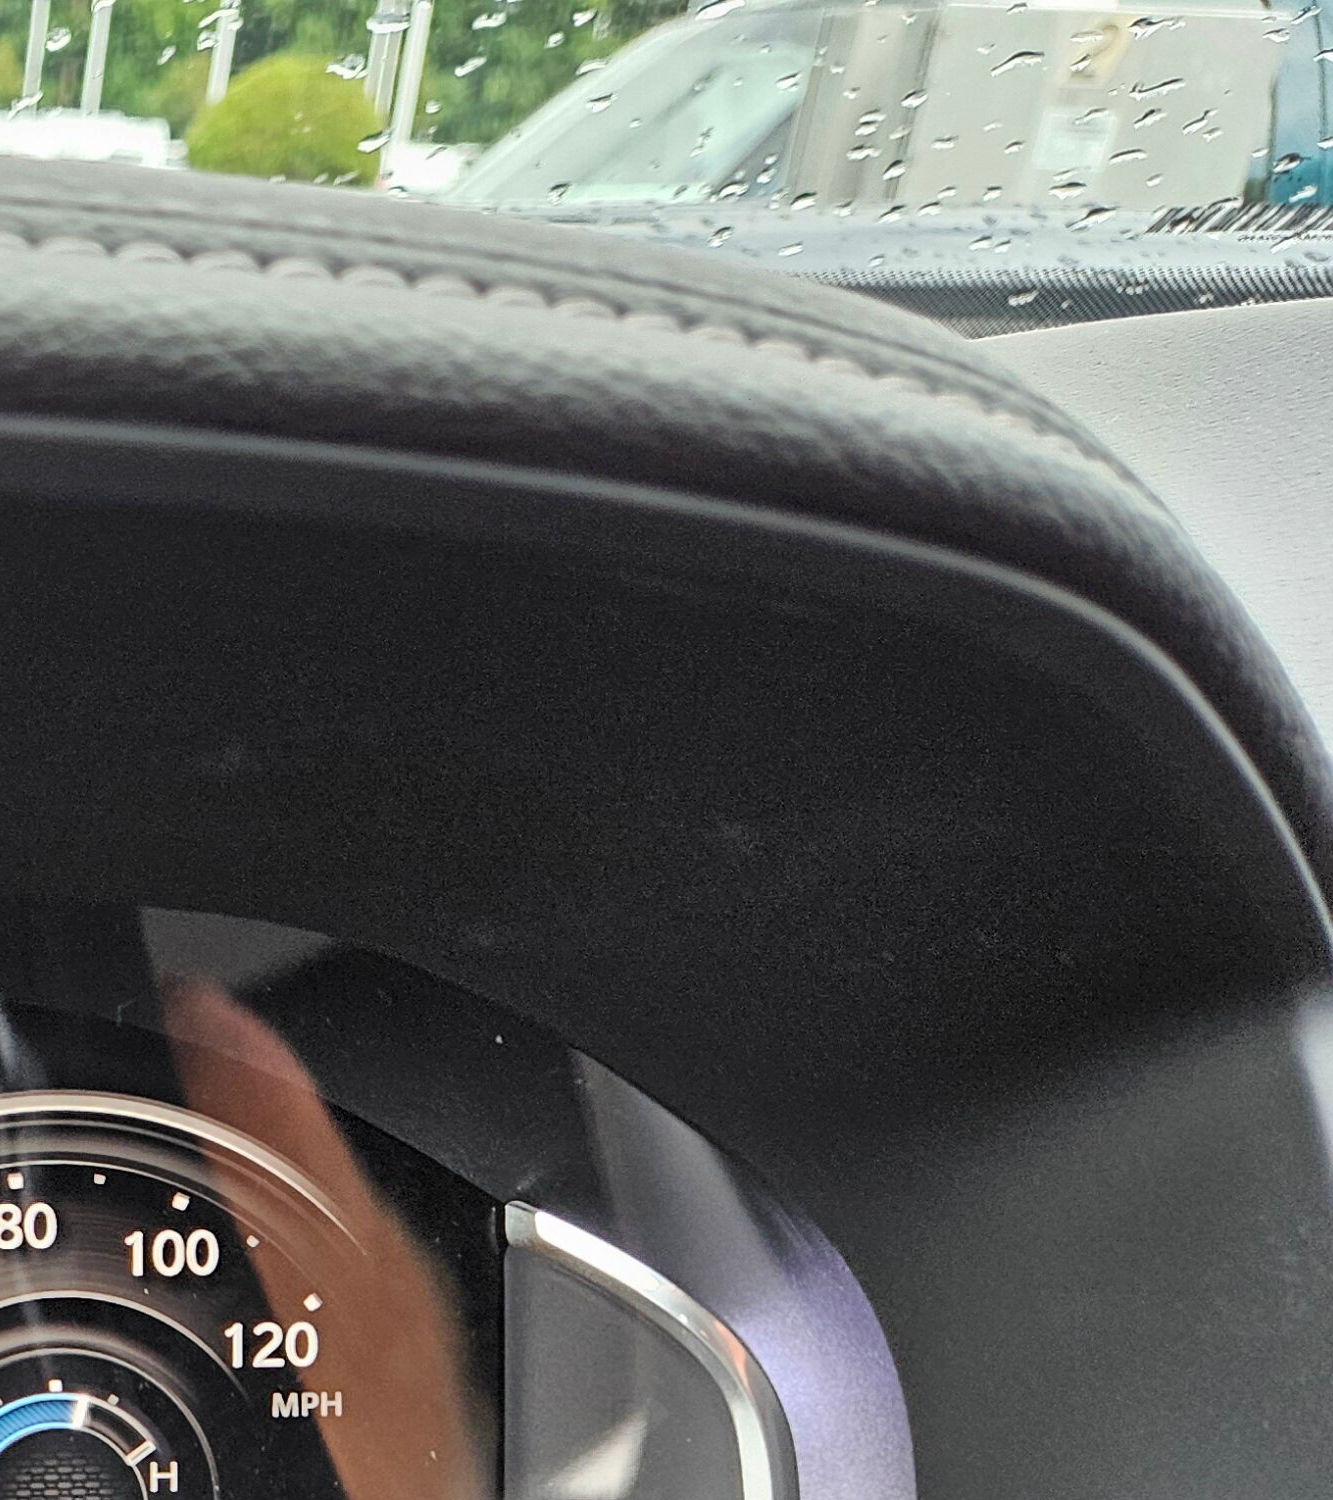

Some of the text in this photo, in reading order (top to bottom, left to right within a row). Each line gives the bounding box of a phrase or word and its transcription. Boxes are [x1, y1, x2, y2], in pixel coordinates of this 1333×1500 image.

[124, 1229, 220, 1277] 100
[224, 1321, 319, 1369] 120
[270, 1393, 344, 1418] MPH
[149, 1462, 179, 1493] H
